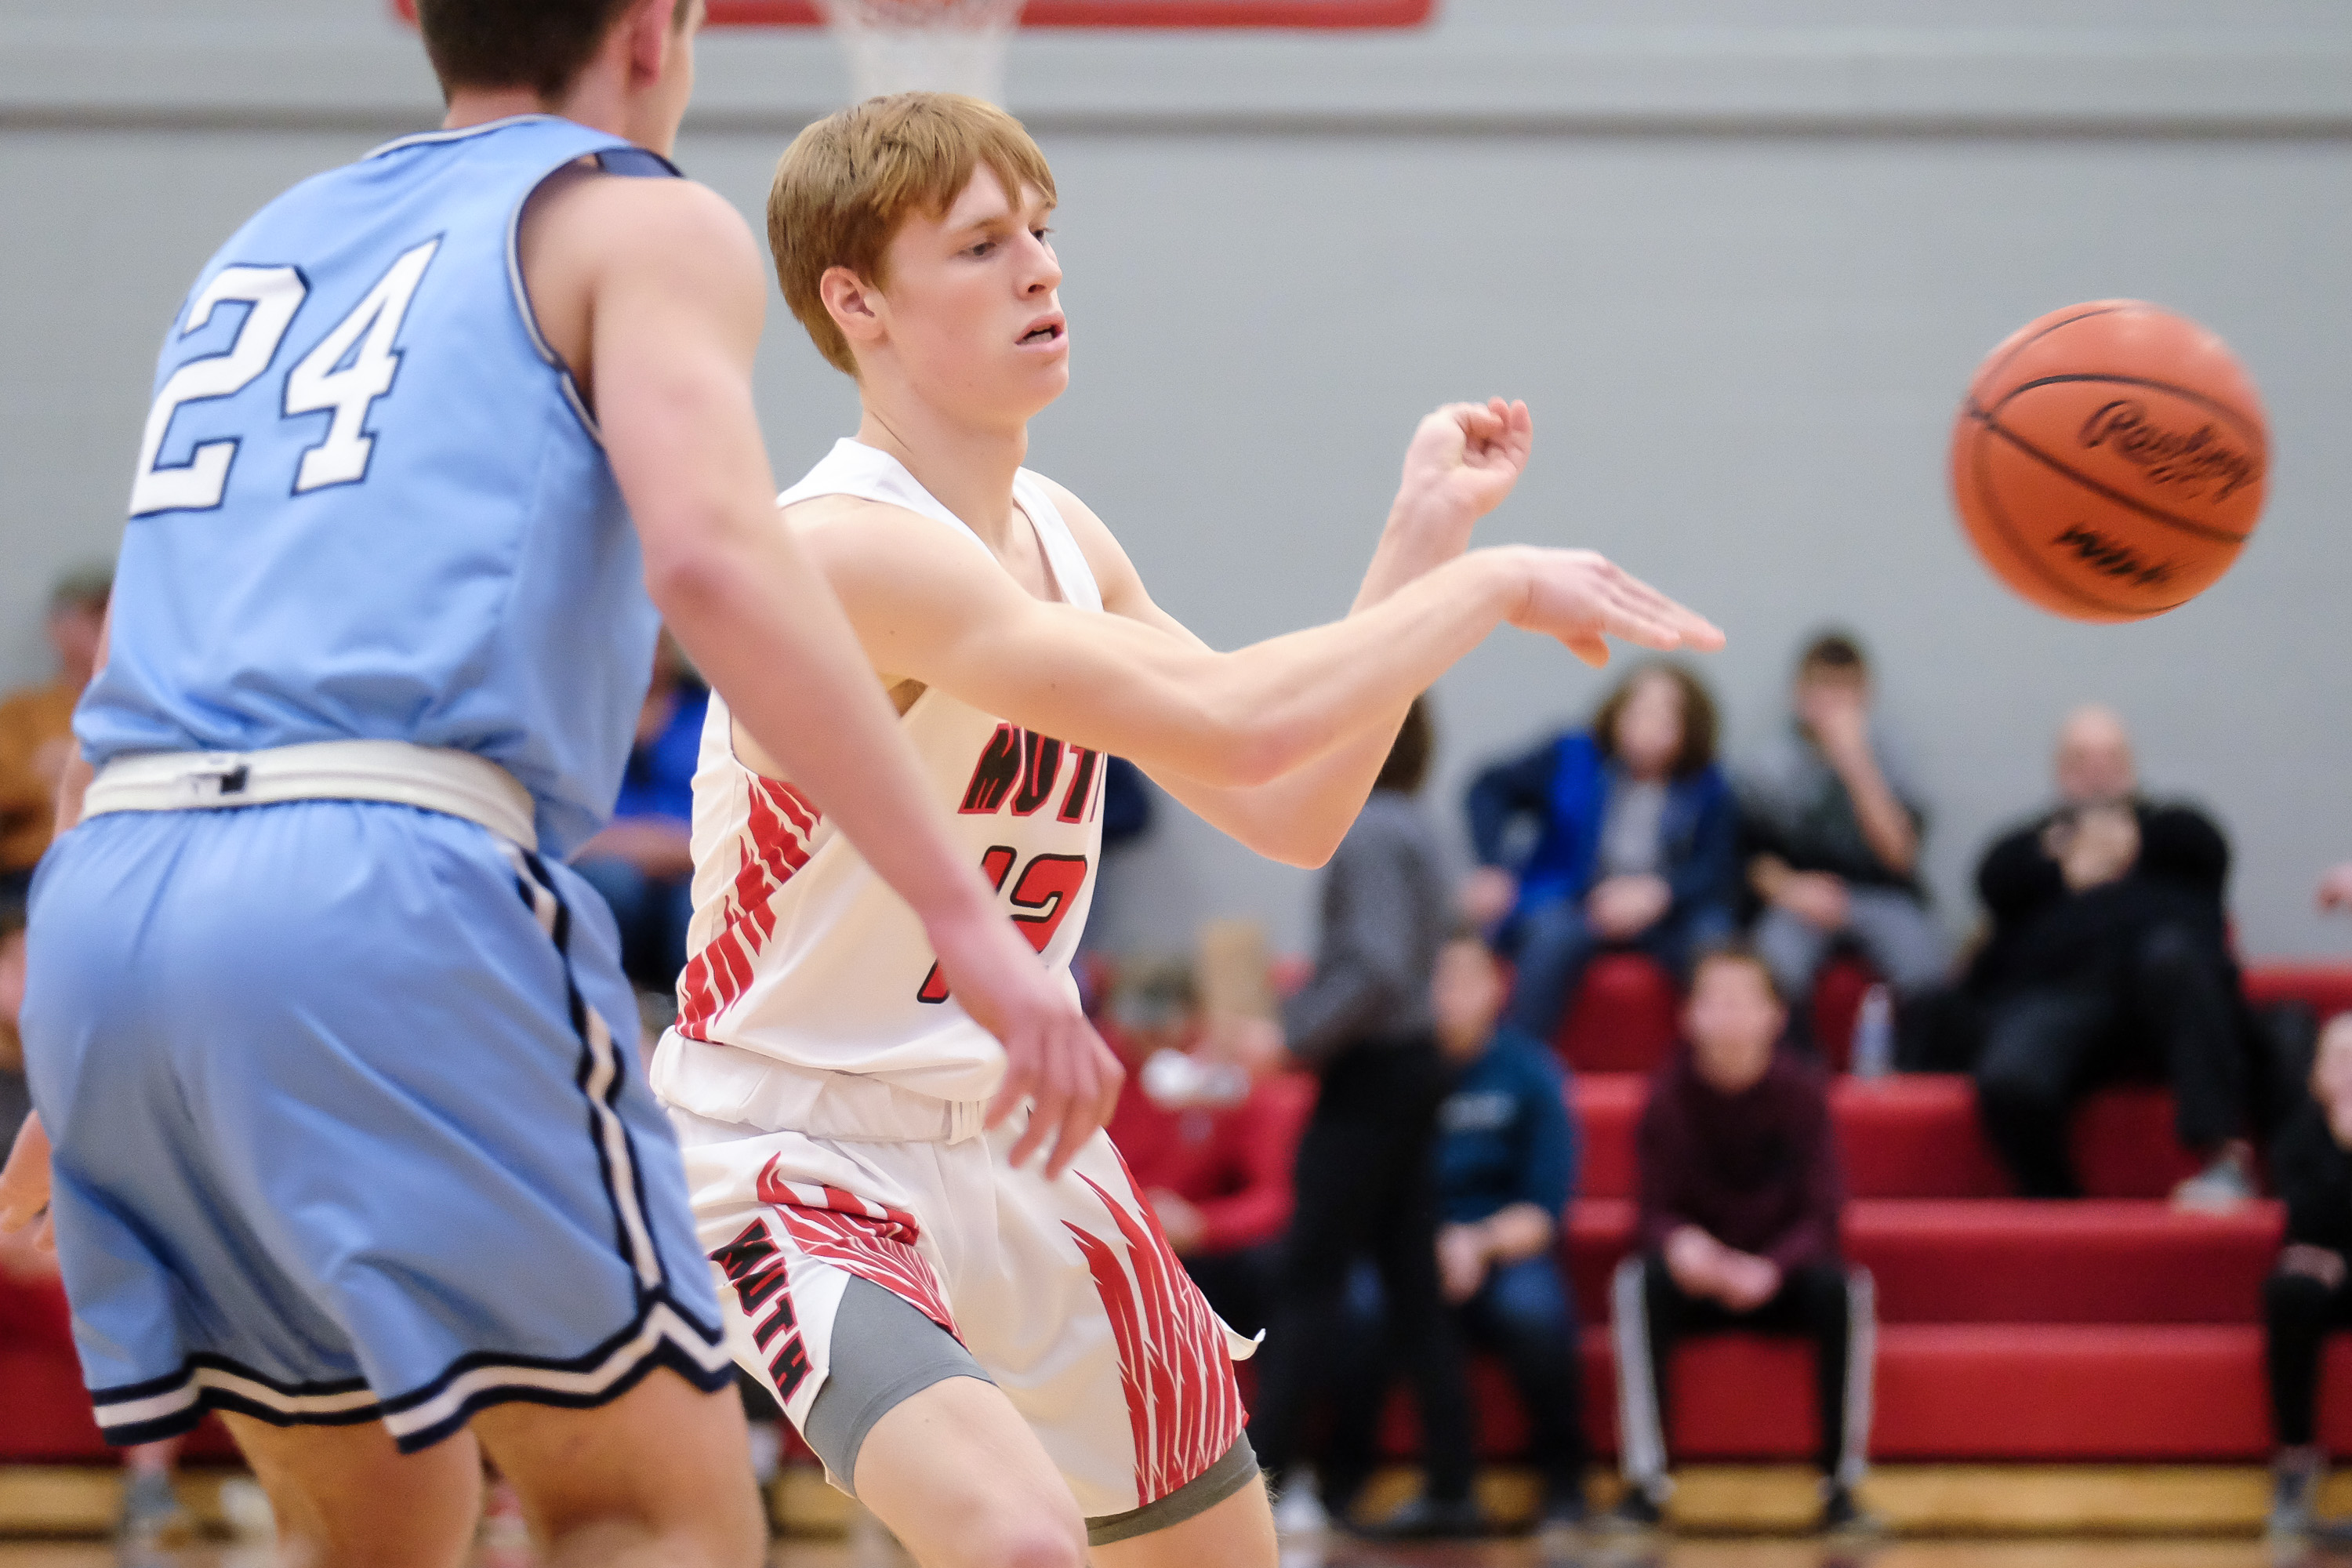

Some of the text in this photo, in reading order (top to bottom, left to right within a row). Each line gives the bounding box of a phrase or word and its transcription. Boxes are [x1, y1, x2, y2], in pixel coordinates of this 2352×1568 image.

[129, 232, 446, 519] 24
[957, 722, 1105, 824] MUT
[707, 1216, 814, 1406] MUTH
